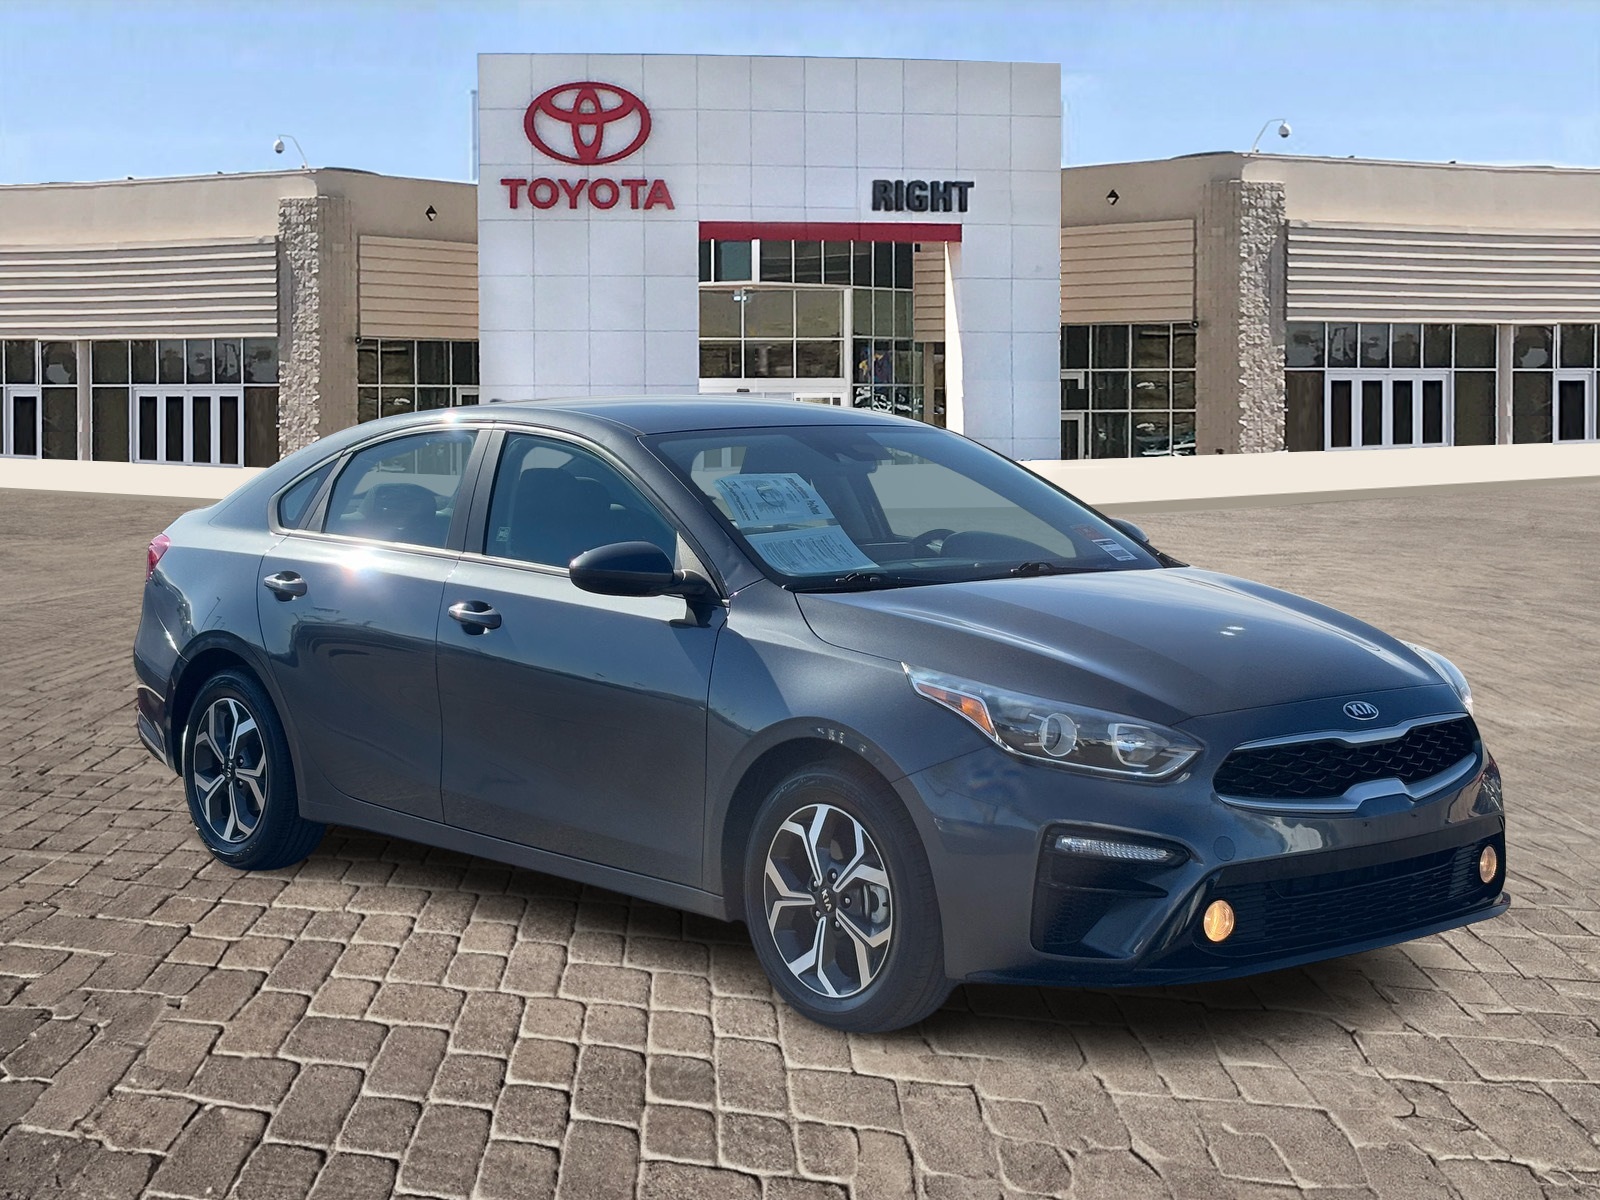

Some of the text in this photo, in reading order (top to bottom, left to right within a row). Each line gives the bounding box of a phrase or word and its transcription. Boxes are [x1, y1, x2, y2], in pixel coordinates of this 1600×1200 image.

[500, 179, 675, 210] TOYOTA
[871, 179, 975, 212] RIGHT
[1346, 703, 1377, 716] KIA
[821, 889, 832, 912] KIA
